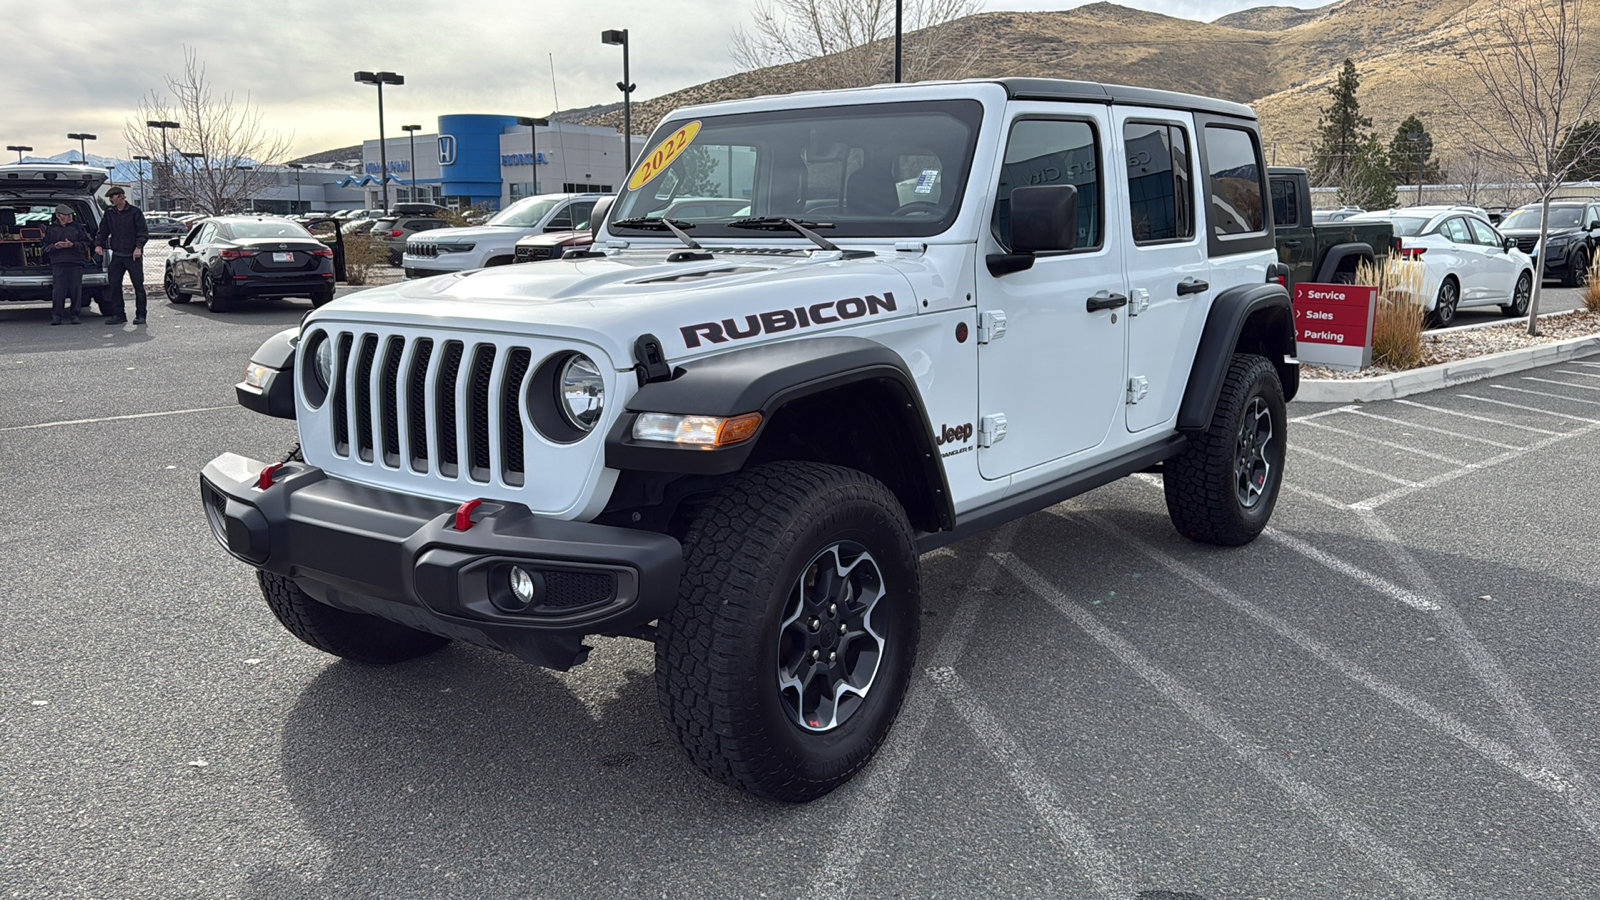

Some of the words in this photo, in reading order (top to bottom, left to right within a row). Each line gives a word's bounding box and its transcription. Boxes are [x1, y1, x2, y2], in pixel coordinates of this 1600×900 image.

[641, 129, 687, 183] 2022
[1307, 290, 1346, 301] Service
[679, 291, 898, 349] RUBICON
[1305, 310, 1334, 320] Sales
[1304, 330, 1345, 343] Parking
[935, 422, 973, 446] Jeep
